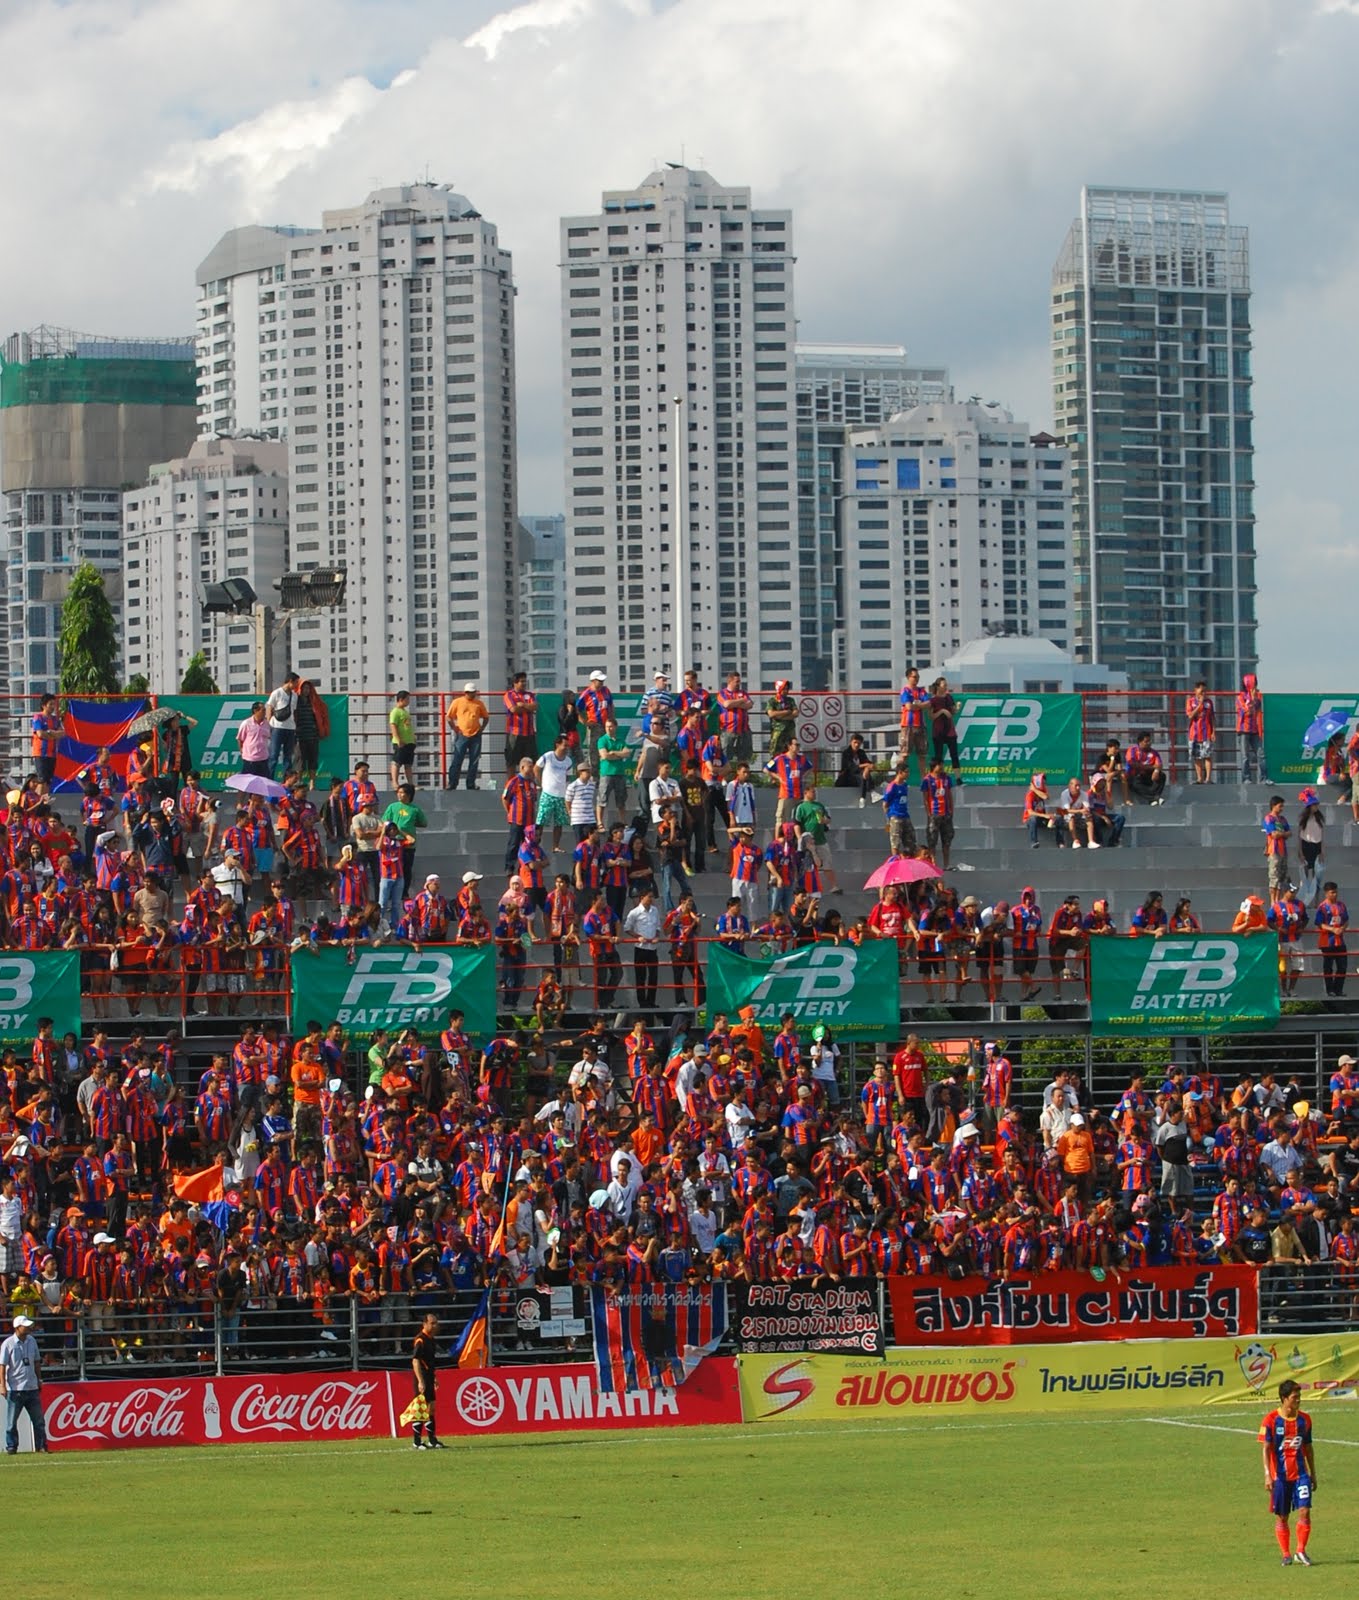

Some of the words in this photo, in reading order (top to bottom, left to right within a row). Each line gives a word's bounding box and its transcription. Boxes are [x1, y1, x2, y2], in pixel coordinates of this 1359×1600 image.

[956, 699, 1043, 744] FB
[944, 746, 1038, 760] ATTERY
[0, 957, 36, 1010] B
[341, 952, 454, 1005] FB
[751, 946, 858, 1000] FB
[1136, 940, 1239, 992] FB
[336, 1006, 448, 1024] BATTERY
[1130, 993, 1233, 1010] BATTERY
[748, 1285, 791, 1306] PAT
[787, 1286, 872, 1311] STADIUM
[834, 1361, 1017, 1407] สปอนเซอร์
[1038, 1363, 1225, 1393] ไทยพรีเมียร์ลีก
[43, 1387, 192, 1442] Coca-Cola
[230, 1381, 379, 1434] Coca-Cola
